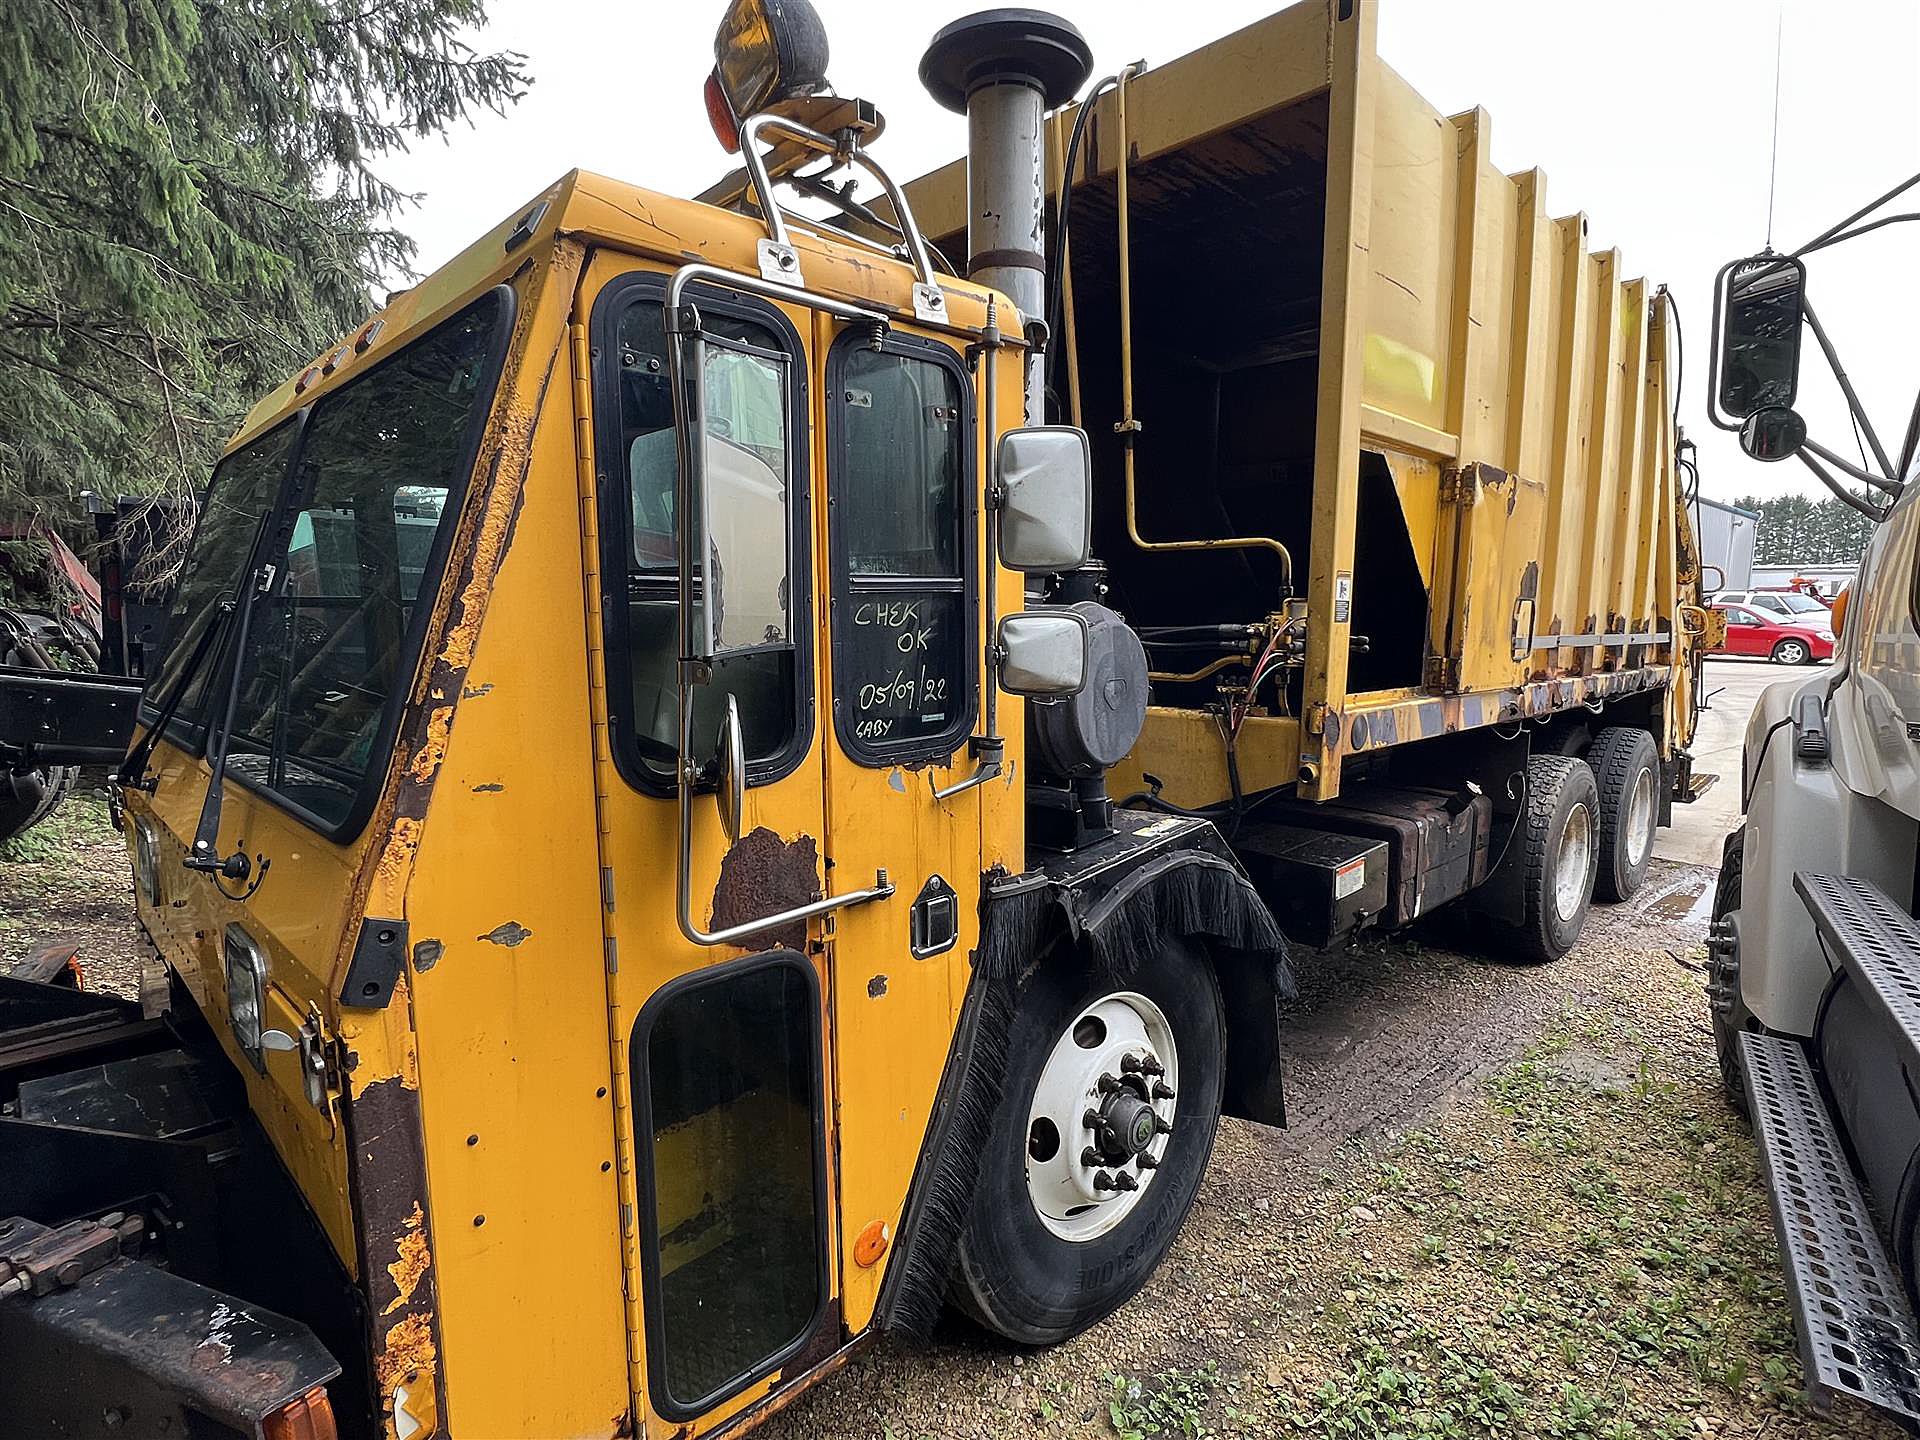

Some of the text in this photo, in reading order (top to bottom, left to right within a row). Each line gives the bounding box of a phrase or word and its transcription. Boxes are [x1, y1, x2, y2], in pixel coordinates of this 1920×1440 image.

[854, 600, 923, 627] CHEK
[897, 627, 932, 652] OK
[859, 664, 947, 710] 05/09/22
